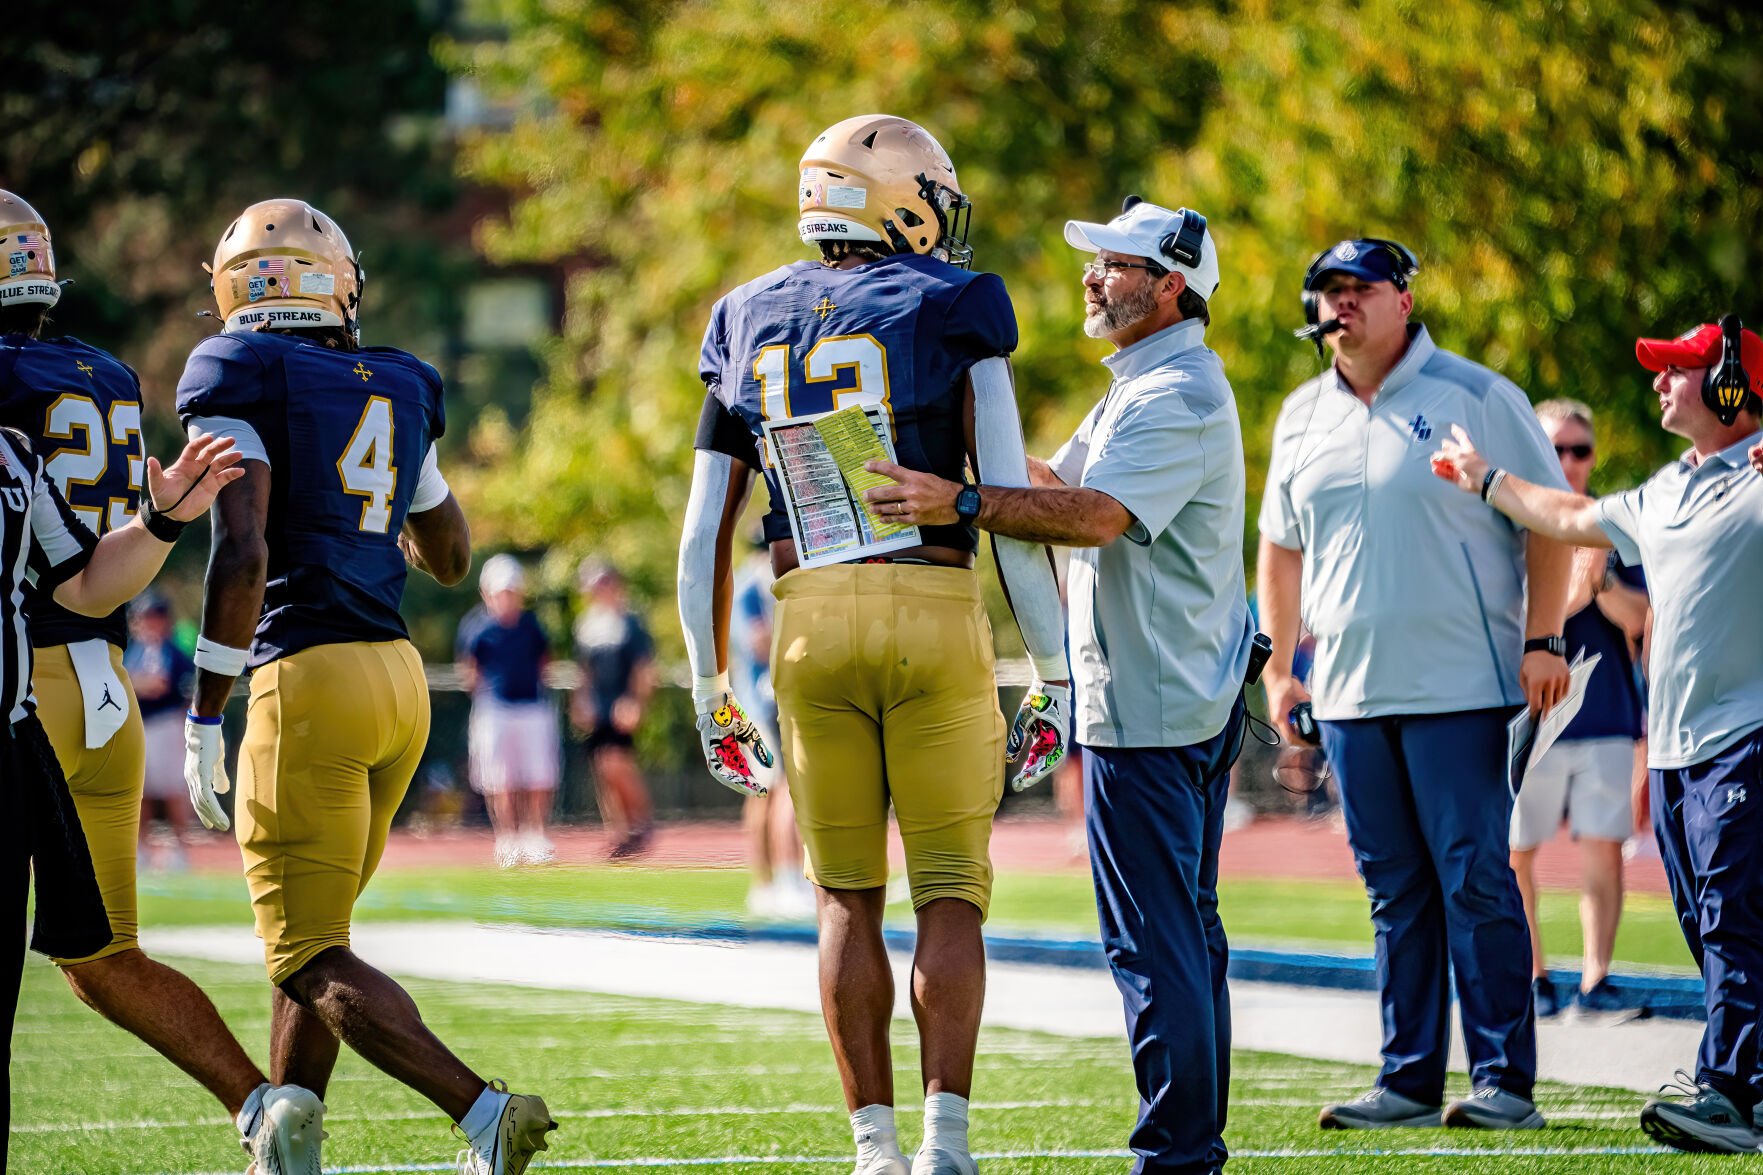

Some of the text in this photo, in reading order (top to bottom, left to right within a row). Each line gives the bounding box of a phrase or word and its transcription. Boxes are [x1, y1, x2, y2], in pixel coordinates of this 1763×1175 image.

[806, 223, 848, 233] STREAKS
[9, 256, 26, 264] GET
[249, 280, 264, 288] GET
[239, 311, 322, 325] BLUE STREAKS
[43, 393, 145, 540] 23
[336, 395, 397, 534] 4
[1, 487, 26, 513] U
